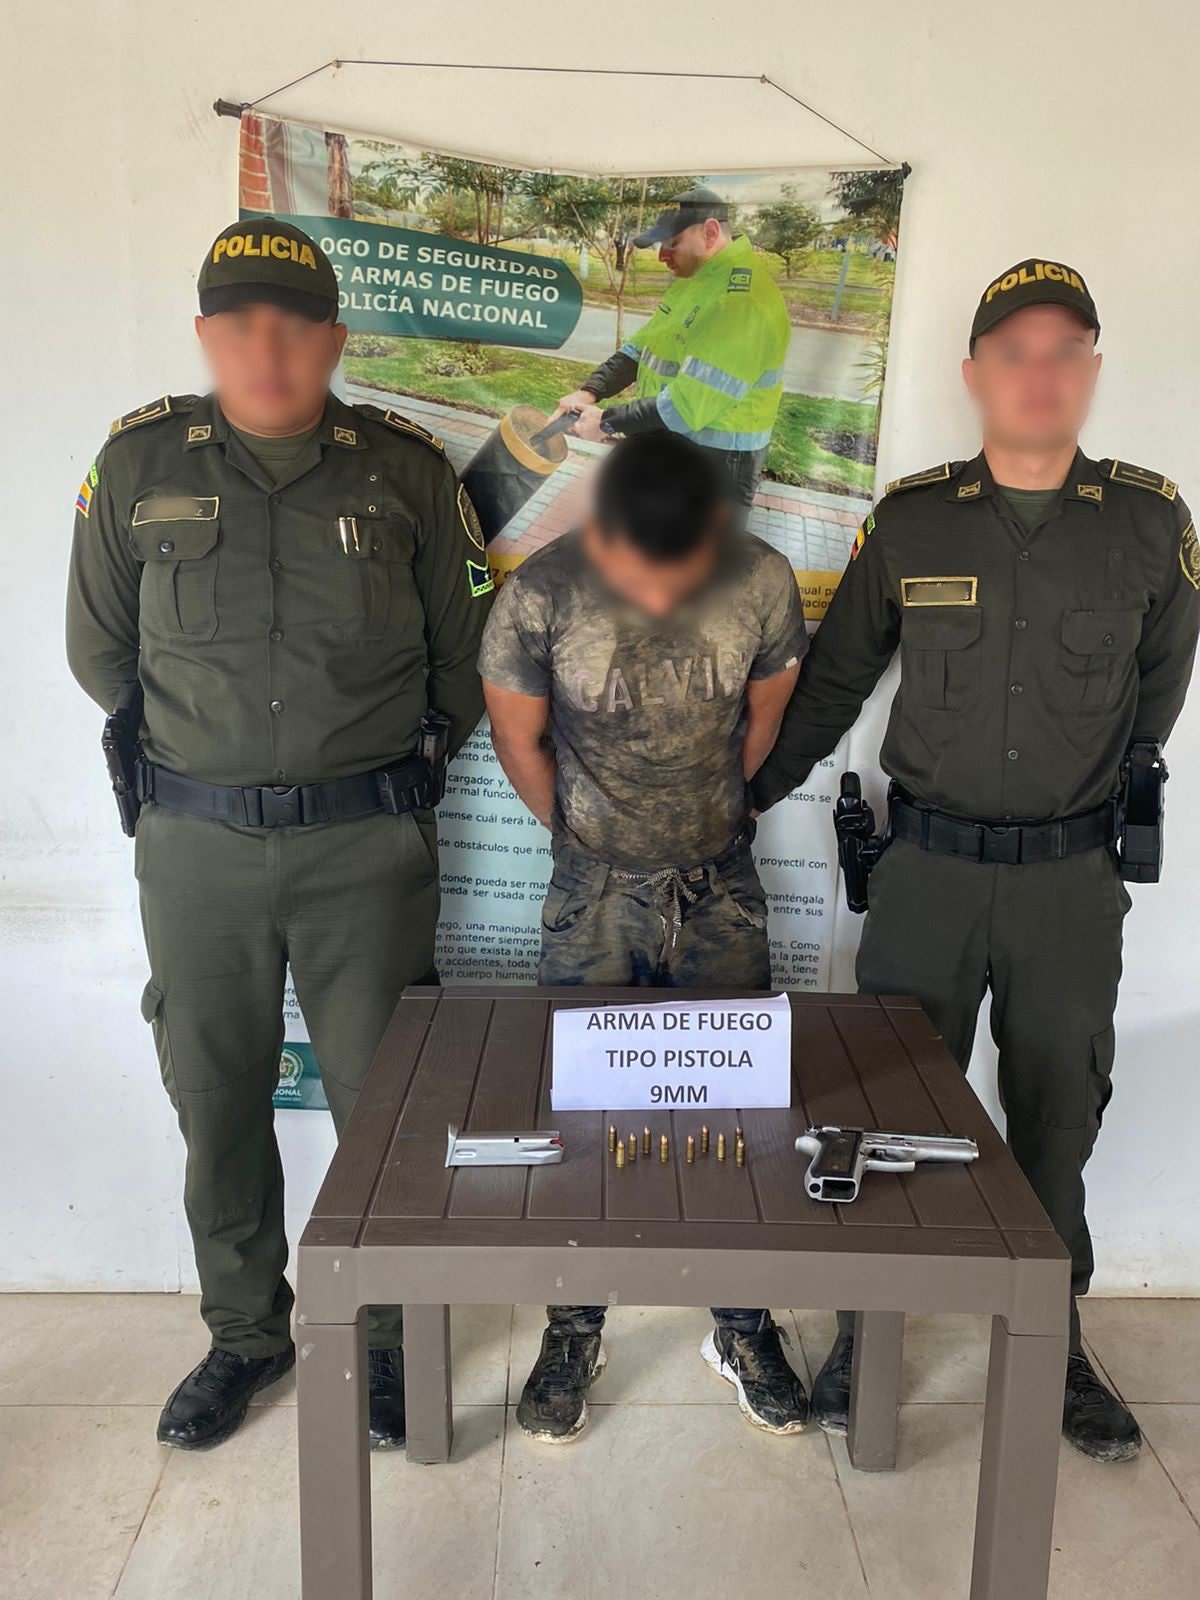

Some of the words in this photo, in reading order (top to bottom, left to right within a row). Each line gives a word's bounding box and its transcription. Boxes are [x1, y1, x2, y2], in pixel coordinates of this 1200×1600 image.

[212, 234, 317, 270] POLICIA
[312, 236, 370, 258] OGO
[378, 241, 409, 261] DE
[416, 246, 559, 280] SEGURIDAD
[350, 266, 433, 289] ARMAS
[441, 274, 472, 294] DE
[480, 279, 559, 303] FUEGO
[985, 263, 1085, 303] POLICIA
[338, 290, 415, 314] OLICÍA
[422, 299, 548, 329] NACIONAL
[447, 773, 494, 786] cargador
[498, 779, 504, 788] y
[460, 787, 480, 796] mal
[787, 792, 815, 802] estos
[819, 794, 832, 803] se
[439, 809, 473, 821] piense
[476, 812, 498, 823] cuál
[501, 815, 524, 826] será
[527, 816, 537, 827] la
[437, 838, 450, 847] de
[454, 839, 509, 853] obstáculos
[513, 845, 533, 856] que
[760, 856, 805, 867] proyectil
[808, 861, 828, 869] con
[440, 873, 473, 885] donde
[475, 877, 507, 887] pueda
[510, 880, 526, 888] ser
[473, 890, 489, 898] ser
[493, 890, 525, 901] usada
[773, 906, 801, 915] entre
[805, 908, 823, 916] sus
[466, 922, 485, 931] una
[445, 933, 496, 943] mantener
[498, 936, 540, 947] siempre
[790, 940, 820, 951] Como
[457, 946, 477, 955] que
[480, 947, 511, 956] exista
[514, 947, 524, 957] la
[780, 951, 789, 961] la
[791, 953, 819, 963] parte
[445, 956, 504, 968] accidentes,
[507, 959, 530, 969] toda
[456, 970, 492, 979] cuerpo
[495, 970, 538, 980] humano
[792, 965, 818, 974] tiene
[804, 977, 817, 986] en
[586, 1012, 656, 1030] ARMA
[663, 1012, 690, 1030] DE
[698, 1012, 773, 1031] FUEGO
[606, 1049, 657, 1068] TIPO
[664, 1049, 753, 1068] PISTOLA
[650, 1084, 708, 1104] 9MM
